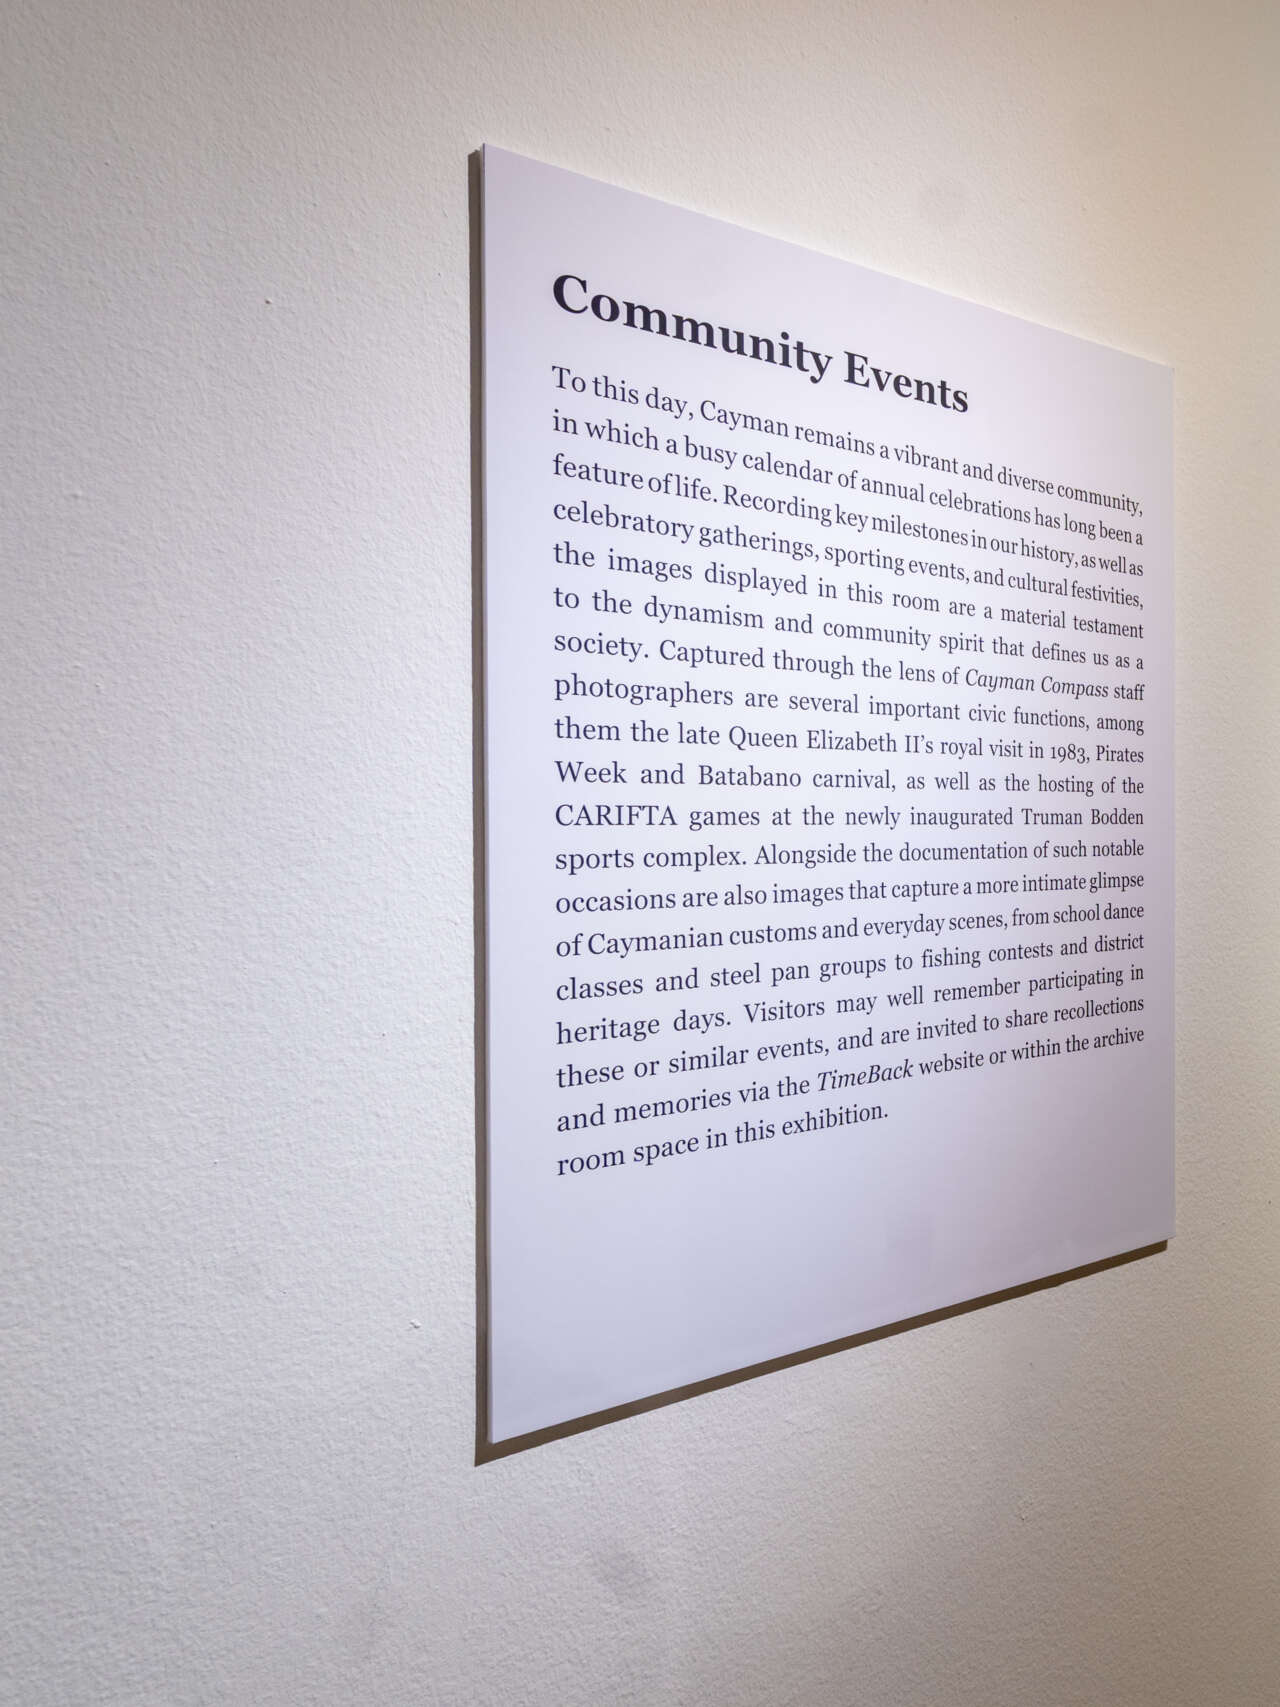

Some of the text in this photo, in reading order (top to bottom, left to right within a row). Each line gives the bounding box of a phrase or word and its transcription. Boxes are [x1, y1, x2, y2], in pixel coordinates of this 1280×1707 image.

[552, 274, 969, 413] Community Events
[551, 365, 1143, 518] To this day, Cayman remains a vibrant and diverse community,
[552, 408, 1144, 546] in which a busy calendar of annual celebrations has long been a
[552, 540, 1144, 639] the images displayed in this room are a material testament
[554, 631, 1146, 701] society. Captured through the lens of Cayman Compass staff
[554, 672, 1145, 737] photographers are several important civic functions, among
[554, 715, 621, 741] them
[629, 719, 670, 744] the
[677, 721, 720, 746] late
[728, 725, 798, 751] Queen
[806, 729, 898, 753] Elizabeth
[940, 737, 984, 760] royal
[988, 738, 1024, 758] visit
[1028, 740, 1045, 759] in
[1050, 743, 1090, 765] 1983,
[1095, 744, 1144, 764] Pirates
[553, 760, 1144, 798] Week and Batabano carnival, as well as the hosting of the
[555, 803, 1144, 832] CARIFTA games at the newly inaugurated Truman Bodden
[555, 838, 1144, 876] sports complex. Alongside the documentation of such notable
[555, 871, 1144, 914] occasions are also images that capture a more intimate glimpse
[556, 902, 1145, 959] of Caymanian customs and everyday scenes, from school dance
[556, 932, 1144, 1001] classes and steel pan groups to fishing contests and district
[555, 963, 1144, 1045] heritage days. Visitors may well remember participating in
[555, 996, 1144, 1089] these or similar events, and are invited to share recollections
[556, 1026, 1145, 1133] and memories via the TimeBack website or within the archive
[557, 1103, 889, 1176] room space in this exhibition.
